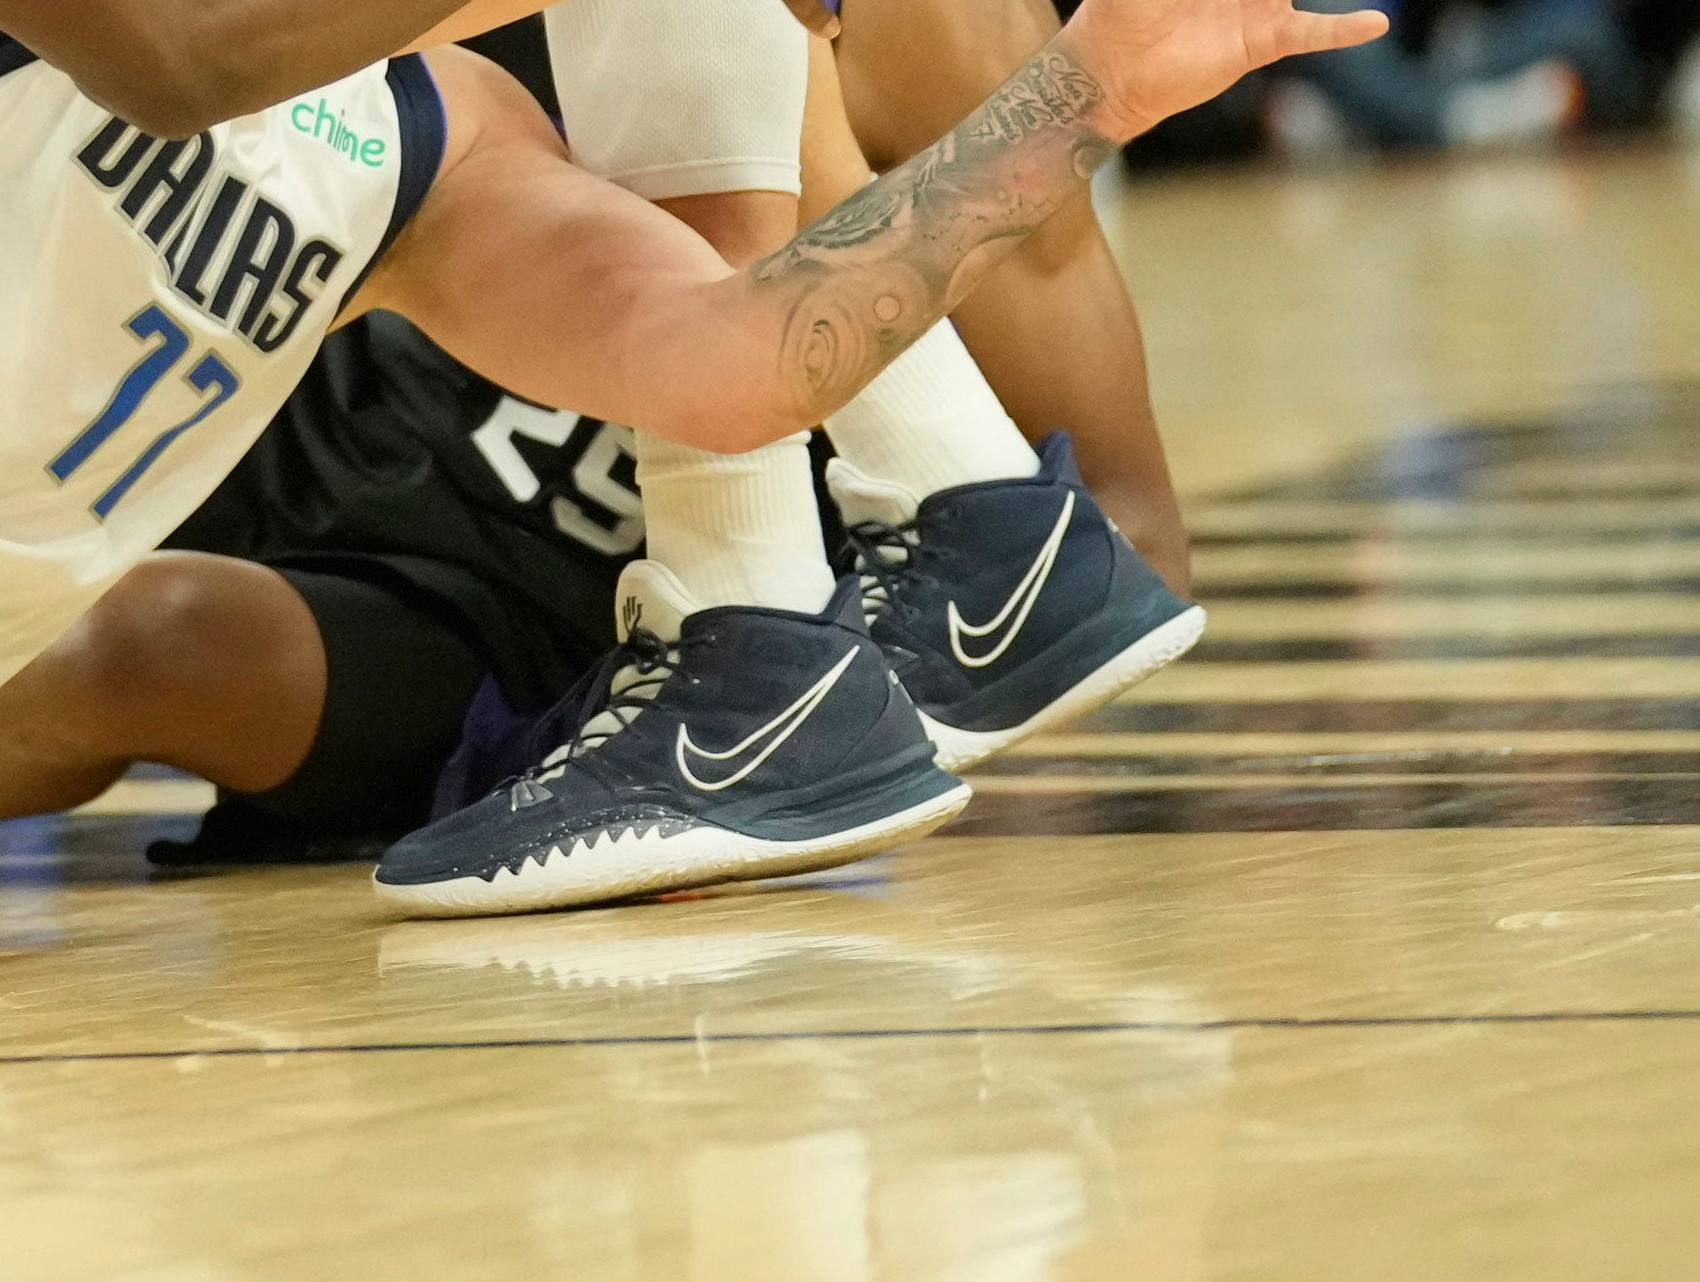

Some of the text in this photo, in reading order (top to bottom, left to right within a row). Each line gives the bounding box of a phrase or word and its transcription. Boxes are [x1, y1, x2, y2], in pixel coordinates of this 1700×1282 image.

[70, 115, 346, 355] DALAS
[291, 98, 386, 168] chime
[44, 299, 243, 521] 77
